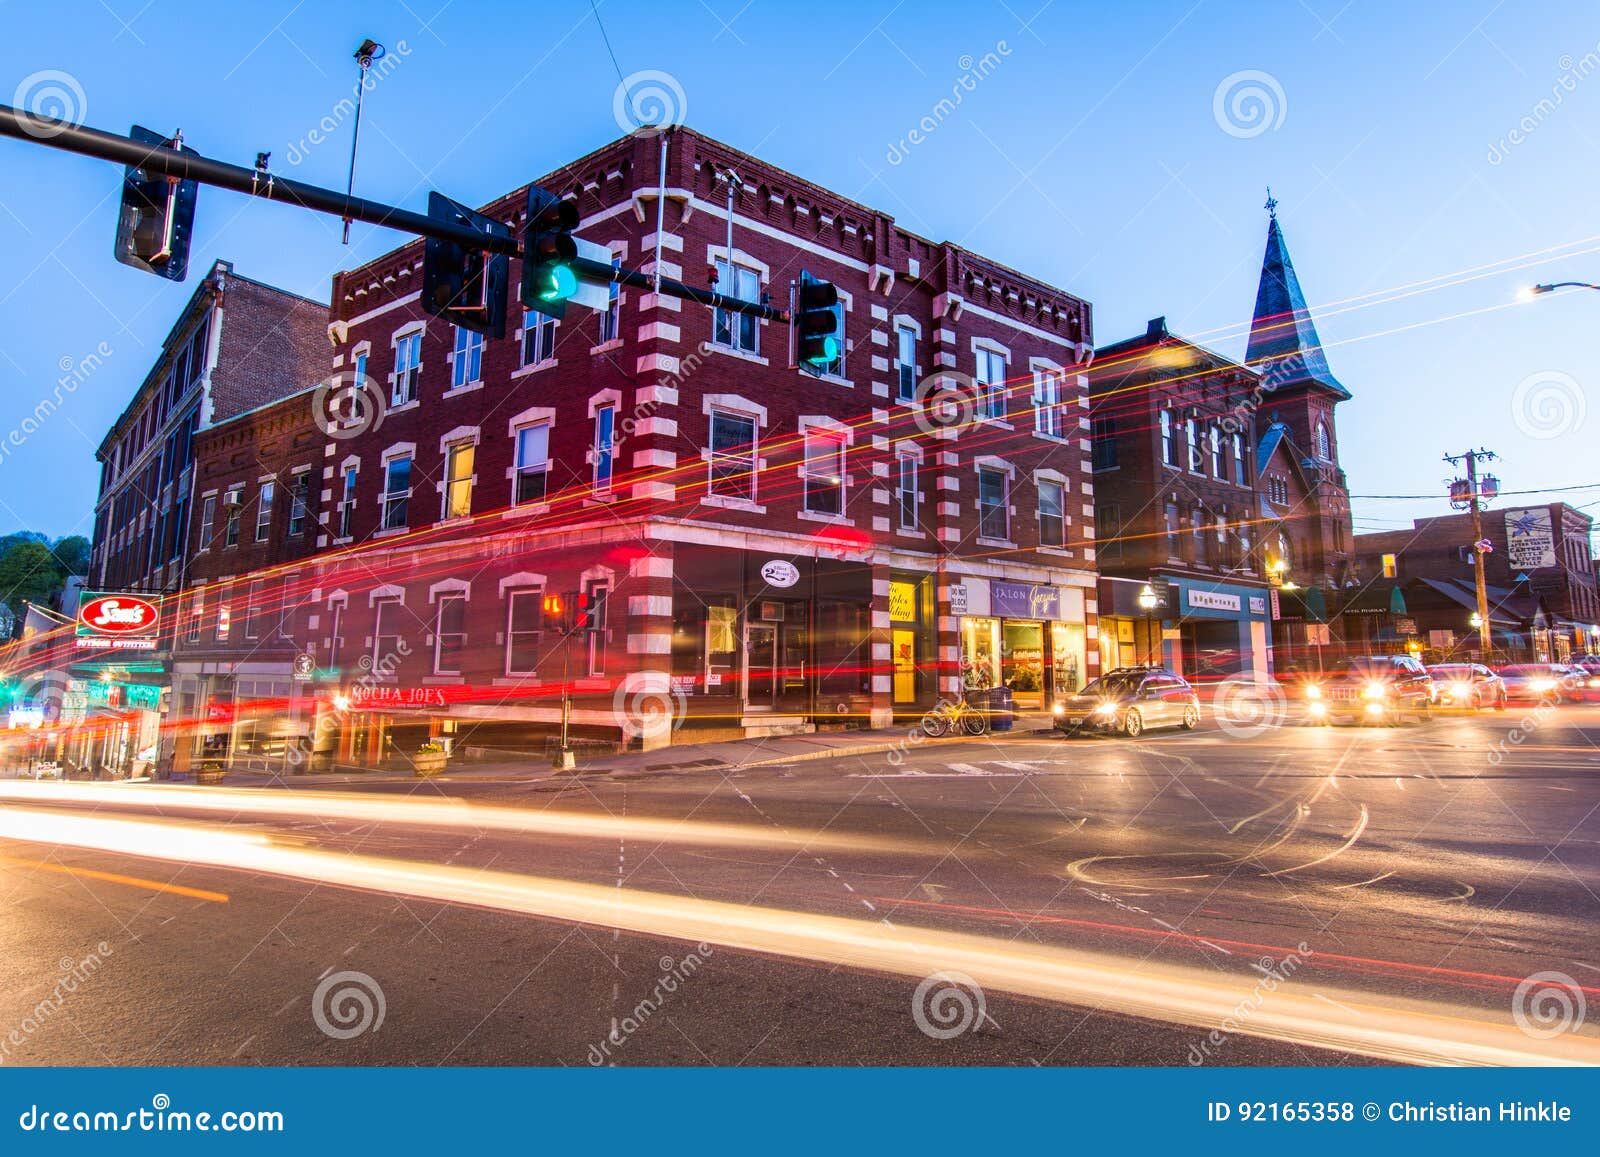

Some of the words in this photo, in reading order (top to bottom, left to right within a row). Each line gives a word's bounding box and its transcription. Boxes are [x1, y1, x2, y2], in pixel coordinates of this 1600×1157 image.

[994, 588, 1026, 599] SALON
[94, 600, 144, 624] Sam's
[351, 686, 402, 704] MOCHA
[407, 688, 446, 706] JOE'S
